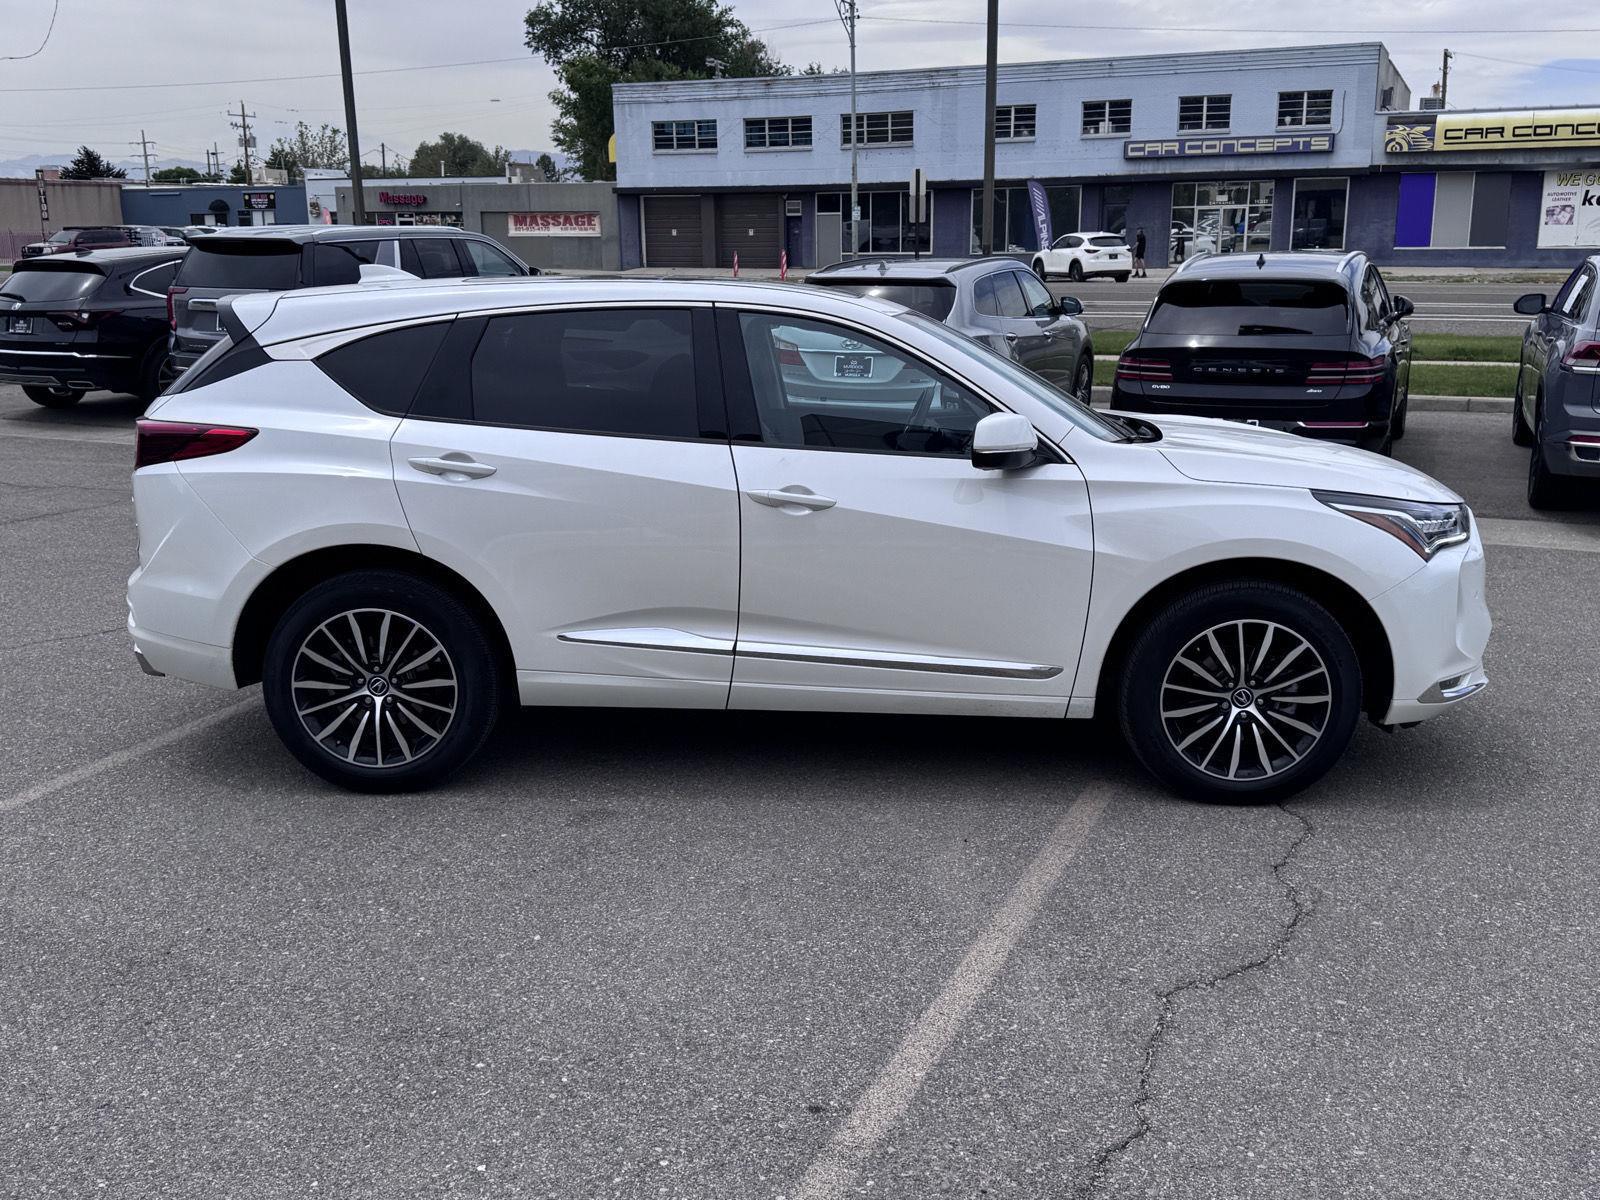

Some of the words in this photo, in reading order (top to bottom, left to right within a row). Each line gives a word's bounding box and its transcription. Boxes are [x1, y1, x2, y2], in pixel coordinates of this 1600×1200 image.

[1444, 127, 1505, 140] CAR
[1512, 122, 1600, 138] CONC
[1127, 142, 1180, 156] CAR
[1185, 136, 1330, 154] CONCEPTS
[1556, 173, 1582, 187] WE
[37, 172, 48, 219] TATTOO
[379, 191, 425, 206] Massage
[513, 213, 597, 227] MASSAGE
[1193, 366, 1285, 374] GENESIS
